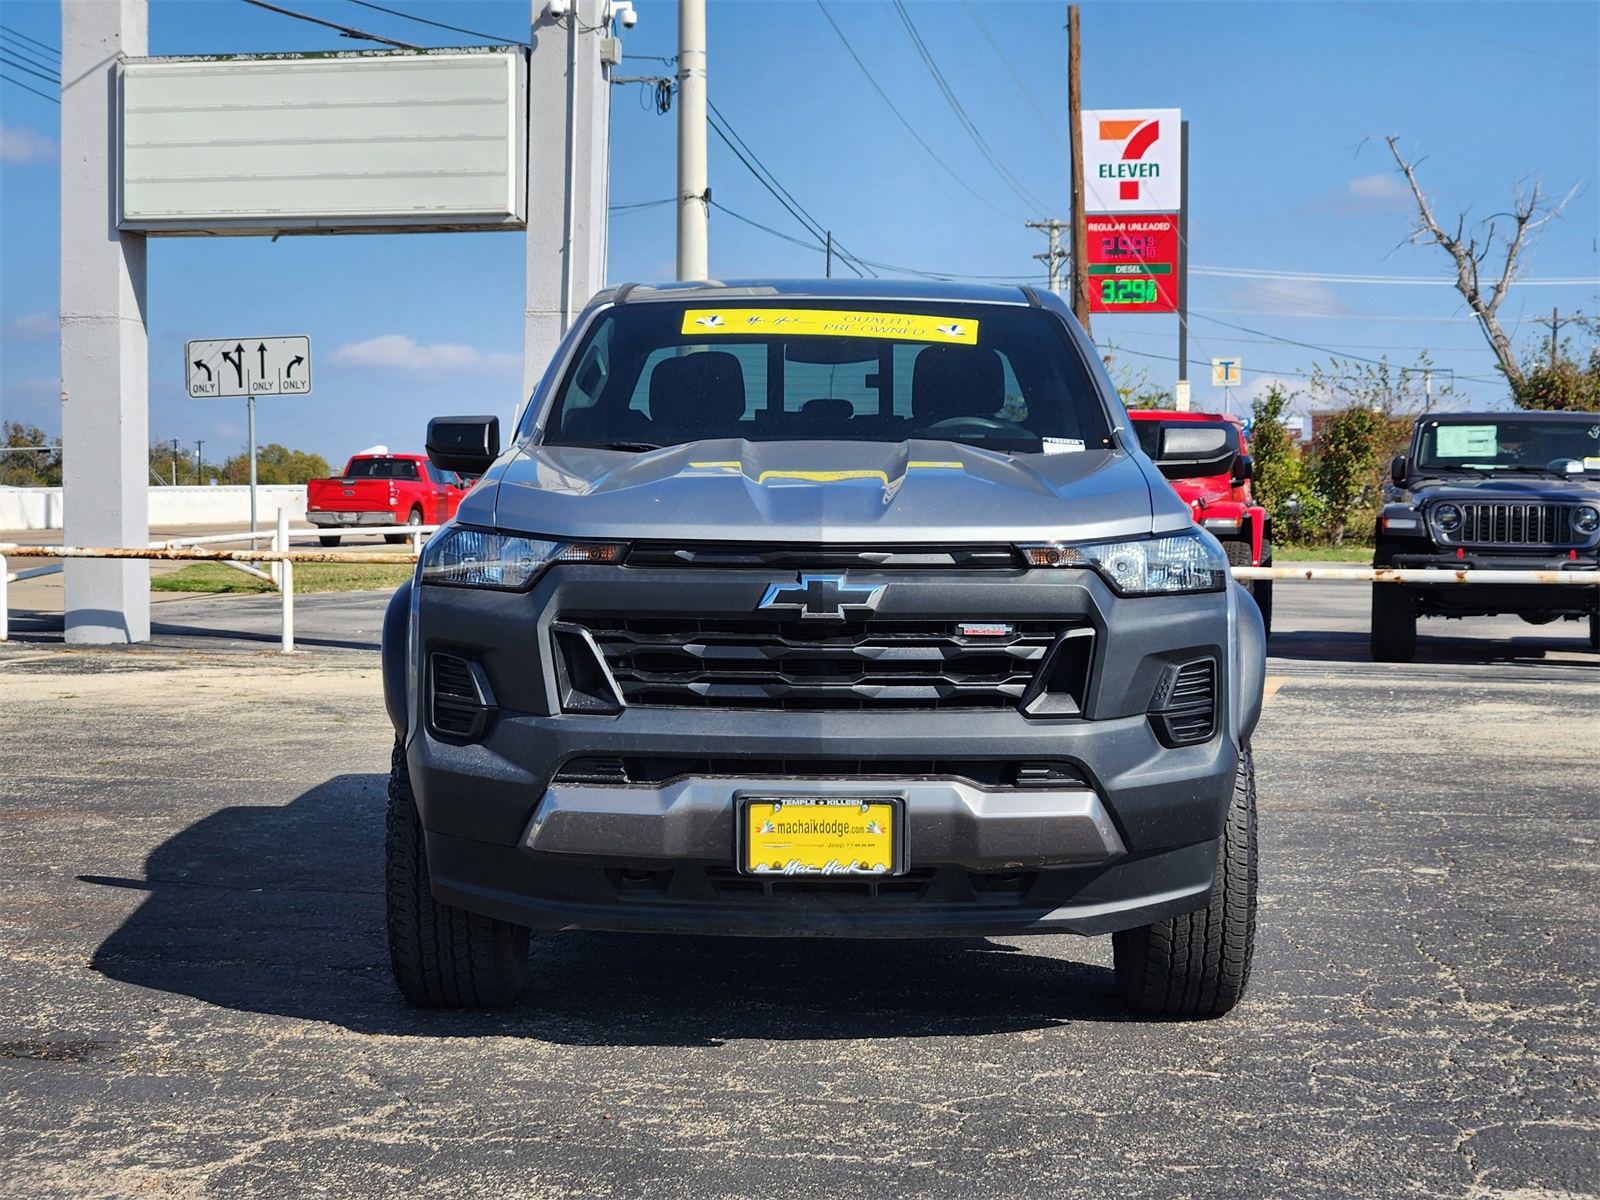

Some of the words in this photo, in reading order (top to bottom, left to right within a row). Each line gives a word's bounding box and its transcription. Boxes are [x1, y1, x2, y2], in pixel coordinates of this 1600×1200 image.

[1088, 222, 1126, 232] REGULAR
[1127, 222, 1171, 231] UNLEADED
[1101, 236, 1146, 259] 2.99
[1115, 265, 1142, 273] DIESEL
[1101, 279, 1146, 304] 3.29
[843, 315, 917, 325] QUALITY
[823, 324, 926, 336] PRE-OWNED
[192, 384, 215, 393] ONLY
[252, 381, 274, 391] ONLY
[283, 380, 306, 390] ONLY
[777, 820, 865, 837] machaikdodge.com
[783, 859, 820, 876] Mac
[820, 859, 862, 876] Haik
